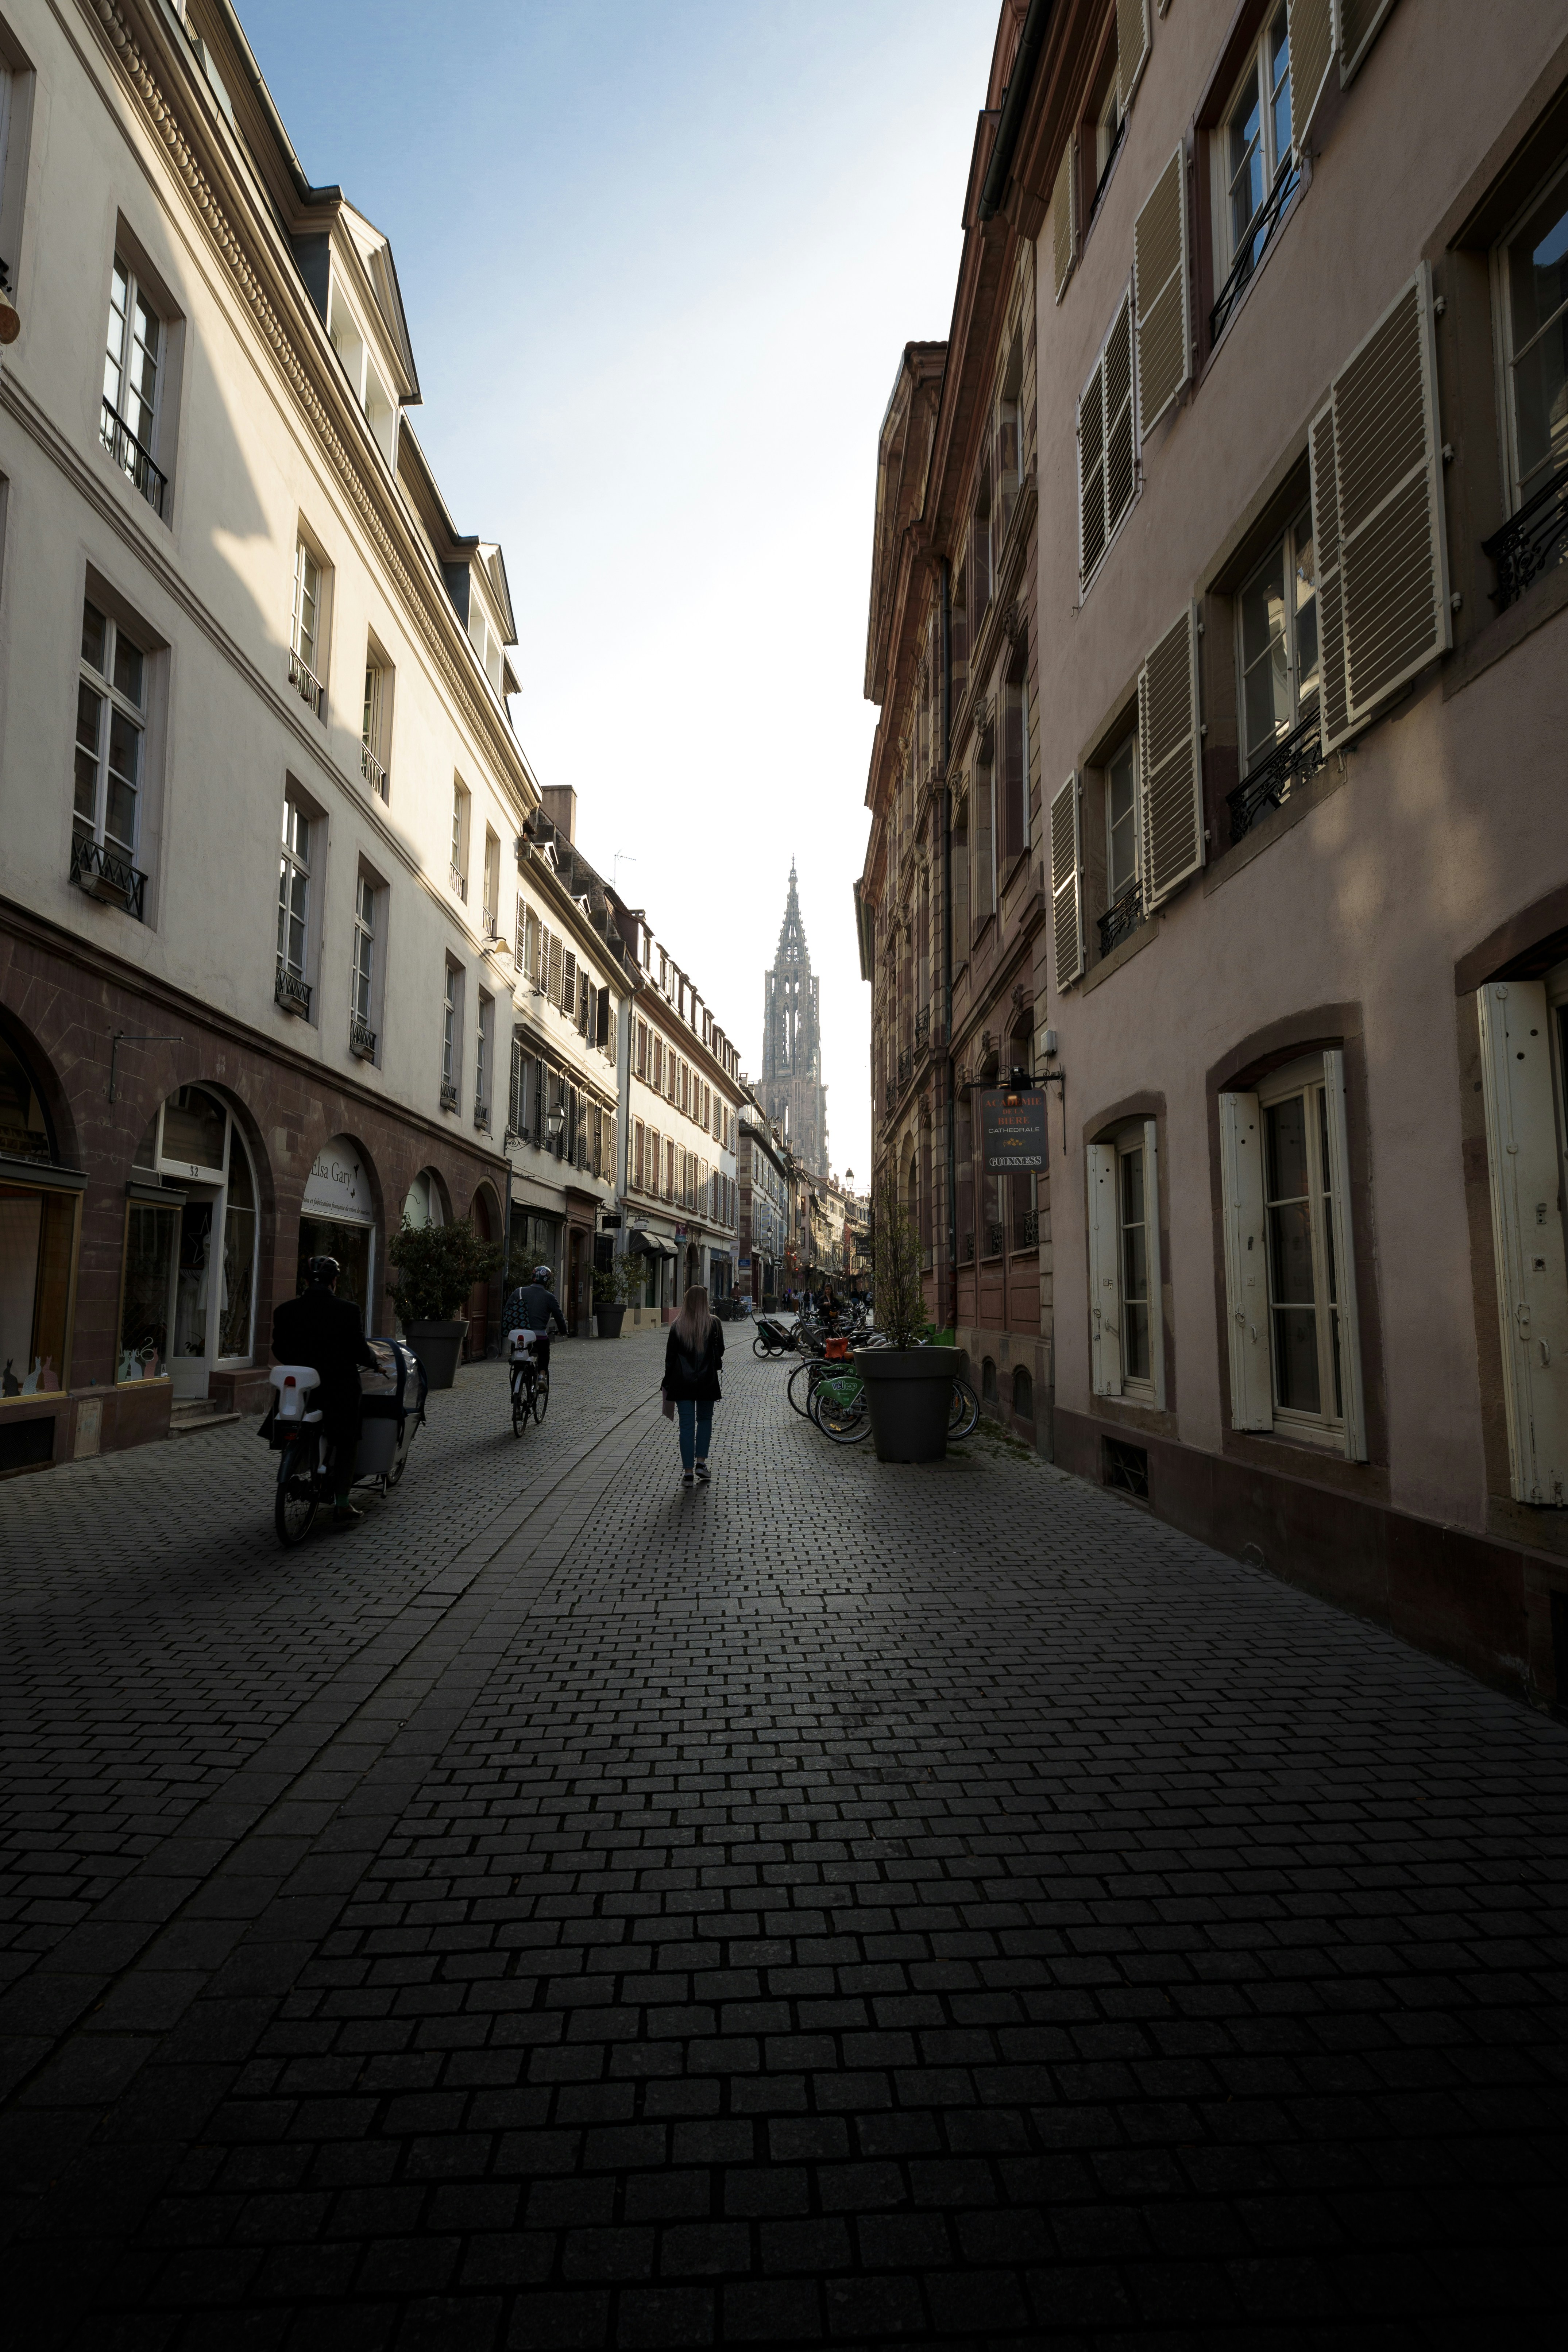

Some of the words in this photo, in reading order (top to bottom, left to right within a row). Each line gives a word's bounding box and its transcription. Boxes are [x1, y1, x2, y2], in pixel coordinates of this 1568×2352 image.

[985, 1097, 1042, 1107] ACADEMIE
[998, 1116, 1030, 1125] BIERE
[989, 1156, 1042, 1166] GUINNESS
[190, 1166, 198, 1177] 32
[331, 1162, 352, 1191] Gary
[313, 1197, 331, 1208] fabrication
